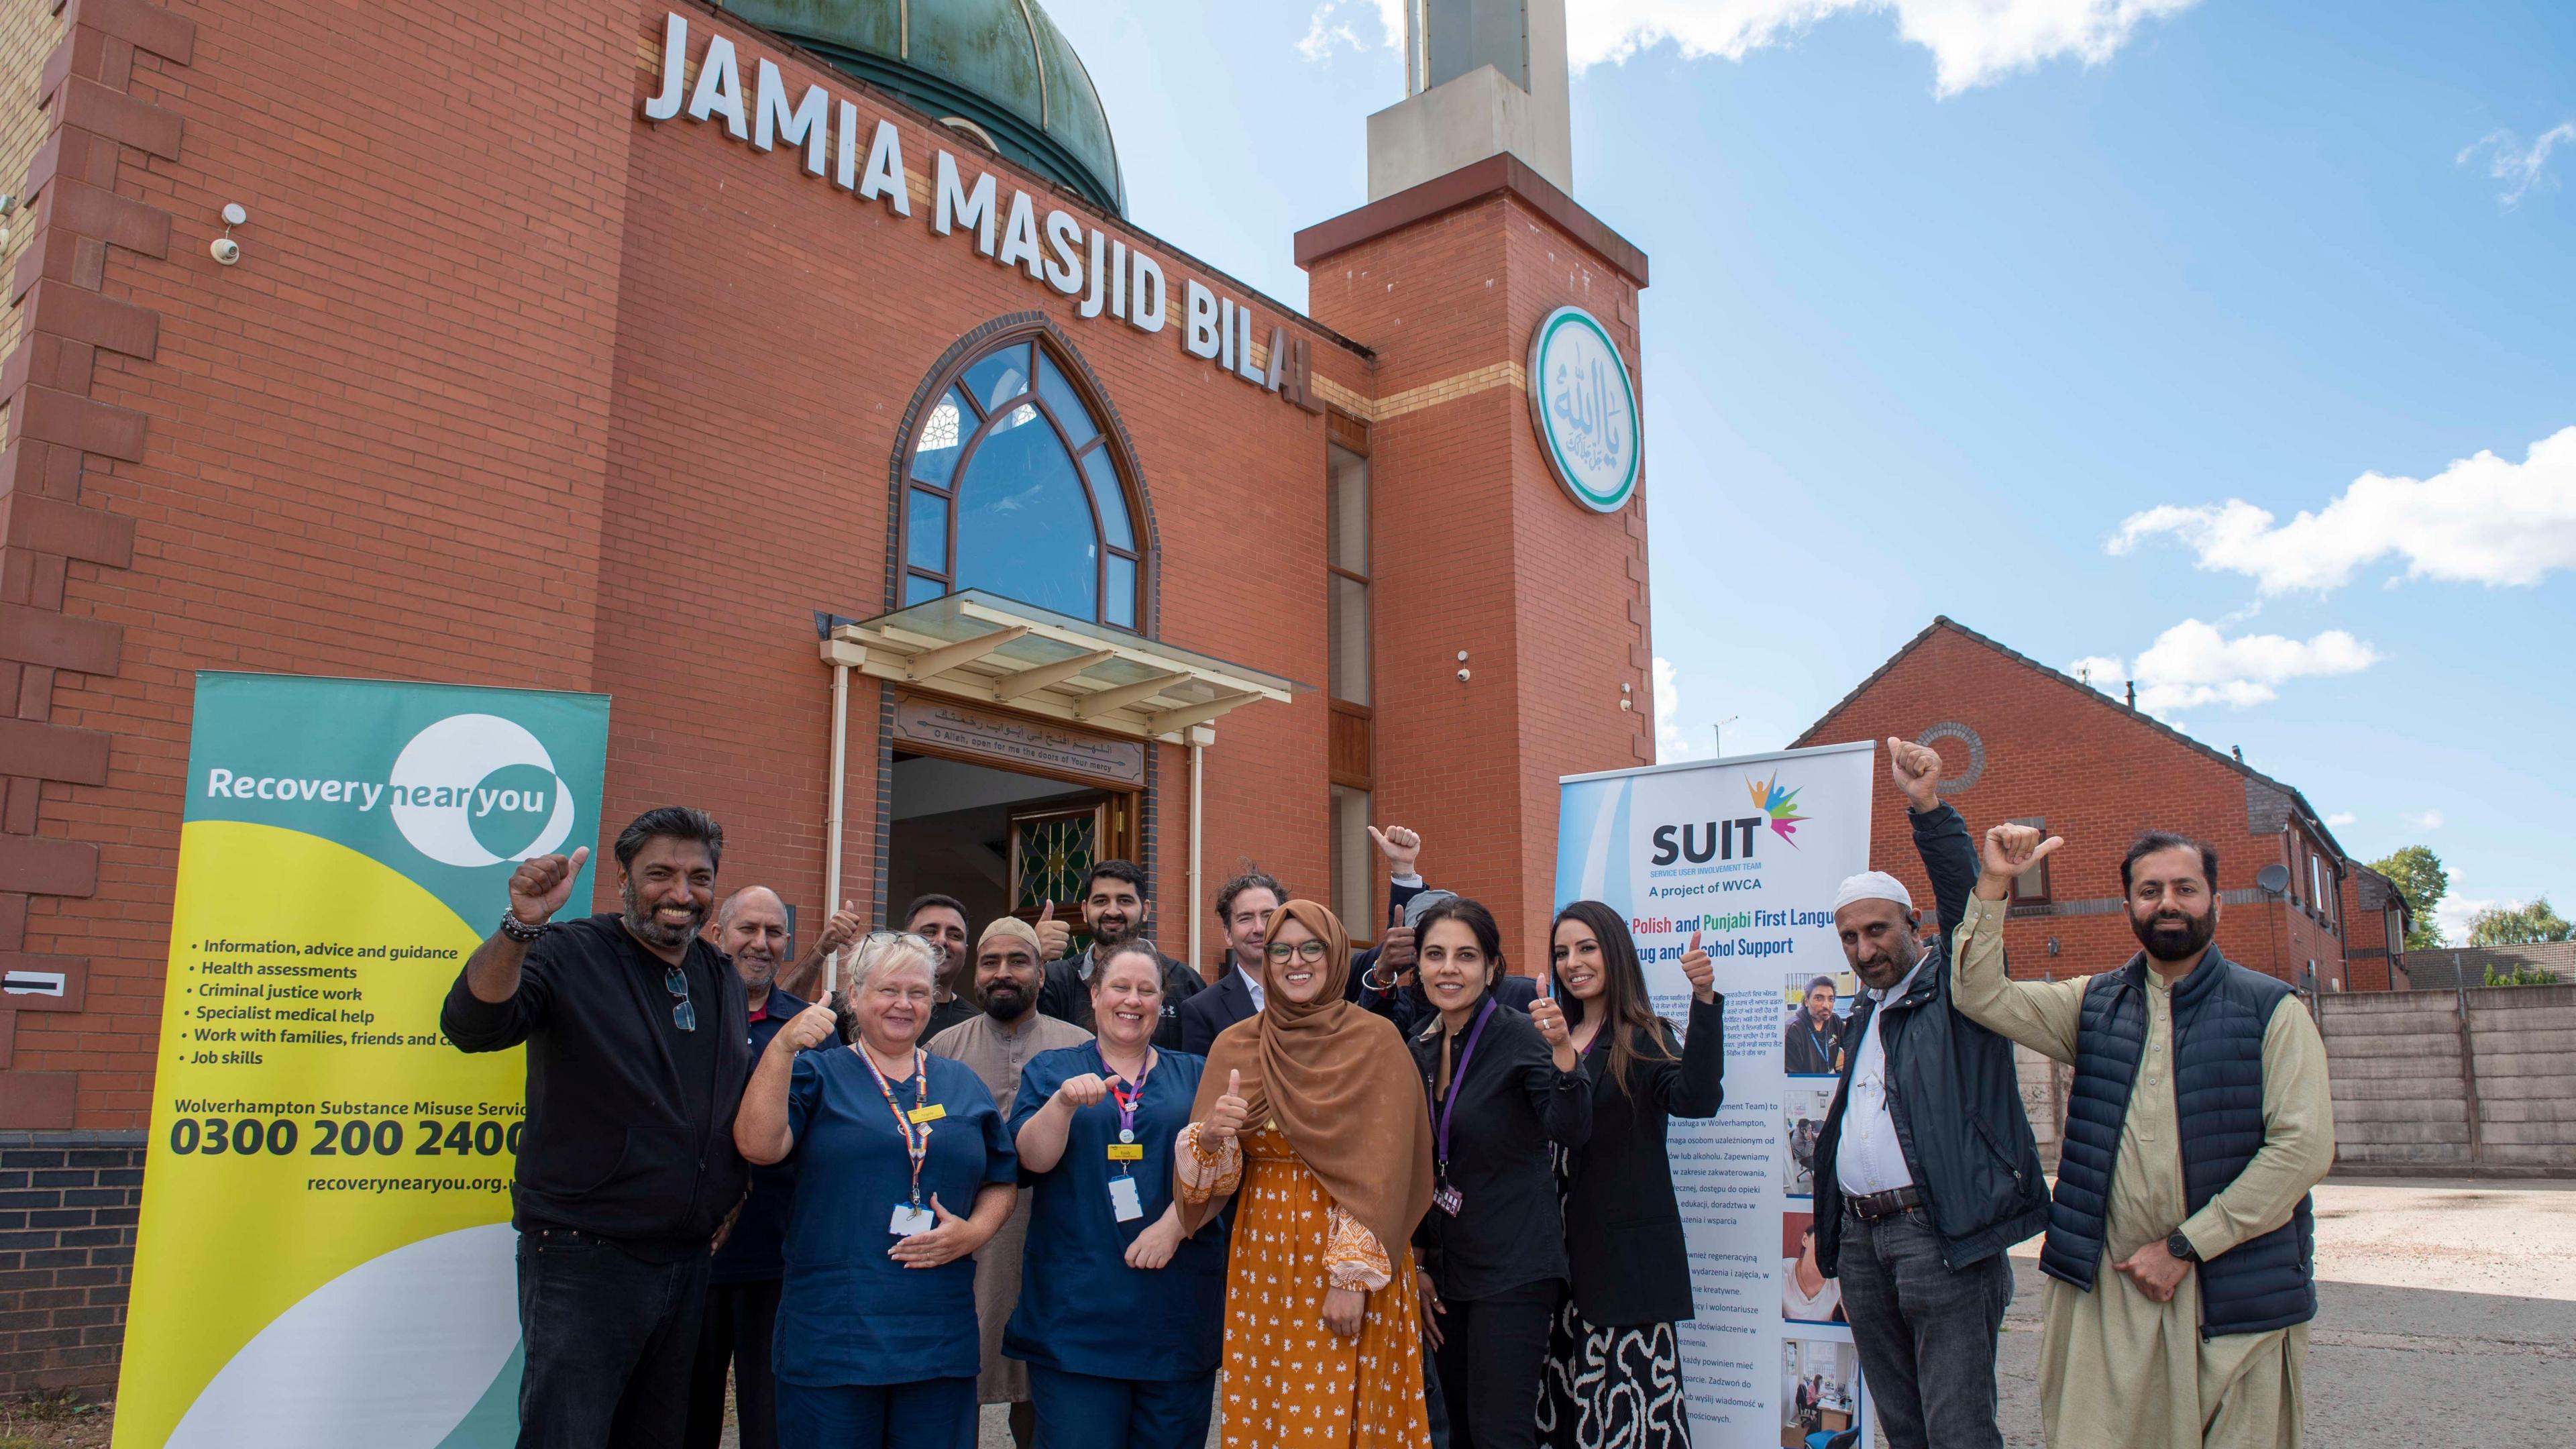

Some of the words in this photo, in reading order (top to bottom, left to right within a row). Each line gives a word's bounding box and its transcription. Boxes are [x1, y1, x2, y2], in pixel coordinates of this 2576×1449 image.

[641, 12, 910, 219] JAMIA
[930, 149, 1166, 334] MASJID
[1182, 278, 1326, 415] BILAL
[934, 729, 941, 737] O
[944, 731, 968, 745] Allah,
[972, 738, 991, 750] open
[994, 741, 1006, 751] for
[1008, 746, 1020, 754] me
[1023, 747, 1035, 757] the
[1038, 751, 1059, 762] doors
[1062, 755, 1069, 763] of
[1071, 756, 1087, 767] Your
[1090, 761, 1112, 772] mercy
[207, 768, 383, 812] Recovery
[390, 784, 471, 808] near
[476, 788, 545, 818] you
[1652, 817, 1762, 865] SUIT
[1650, 869, 1677, 877] SERVICE
[1698, 864, 1742, 875] INVOLVEMENT
[1649, 887, 1658, 896] A
[1662, 885, 1704, 898] project
[1708, 882, 1719, 893] of
[1723, 879, 1762, 891] WVCA
[1633, 917, 1671, 934] Polish
[1676, 915, 1699, 932] and
[1704, 911, 1751, 932] Punjabi
[1755, 910, 1786, 927] First
[1790, 908, 1834, 928] Langu
[204, 939, 301, 956] Information,
[305, 943, 354, 957] advice
[358, 945, 386, 958] and
[390, 947, 458, 961] guidance
[1660, 943, 1684, 960] and
[1738, 937, 1793, 958] Support
[202, 961, 253, 975] Health
[258, 965, 357, 979] assessments
[199, 983, 264, 998] Criminal
[266, 985, 319, 1001] justice
[323, 987, 362, 1001] work
[196, 1006, 272, 1022] Specialist
[275, 1008, 337, 1022] medical
[341, 1010, 374, 1026] help
[194, 1029, 236, 1041] Work
[240, 1029, 276, 1042] with
[280, 1030, 347, 1046] families,
[351, 1032, 403, 1045] friends
[407, 1033, 436, 1045] and
[191, 1051, 218, 1064] Job
[222, 1051, 263, 1065] skills
[175, 1099, 315, 1117] Wolverhampton
[321, 1101, 409, 1116] Substance
[414, 1102, 473, 1116] Misuse
[478, 1102, 526, 1116] Servic
[1746, 1103, 1768, 1111] Team)
[1678, 1120, 1699, 1128] usługa
[170, 1118, 298, 1156] 0300
[310, 1120, 403, 1156] 200
[1715, 1136, 1762, 1146] uzależnionym
[1724, 1153, 1769, 1162] Zapewniamy
[1708, 1169, 1766, 1177] zakwaterowania,
[307, 1176, 513, 1194] recoverynearyou.org.
[1699, 1185, 1725, 1193] dostępu
[1681, 1200, 1709, 1209] edukacji,
[1711, 1201, 1747, 1209] doradztwa
[1707, 1218, 1737, 1226] wsparcia
[1709, 1253, 1757, 1263] regeneracyjną
[1692, 1268, 1728, 1277] wydarzenia
[1735, 1270, 1760, 1279] zajęcia,
[1704, 1286, 1741, 1295] kreatywne.
[1709, 1304, 1758, 1313] wolontariusze
[1682, 1322, 1696, 1330] sobą
[1698, 1322, 1748, 1333] doświadczenie
[1683, 1356, 1703, 1366] każdy
[1703, 1358, 1733, 1368] powinien
[1736, 1361, 1753, 1369] mieć
[1682, 1375, 1707, 1383] sparcie.
[1709, 1377, 1739, 1387] Zadzwoń
[1742, 1380, 1751, 1388] do
[1695, 1395, 1713, 1404] wyślij
[1715, 1397, 1756, 1407] wiadomość
[1687, 1412, 1731, 1423] znościowych.
